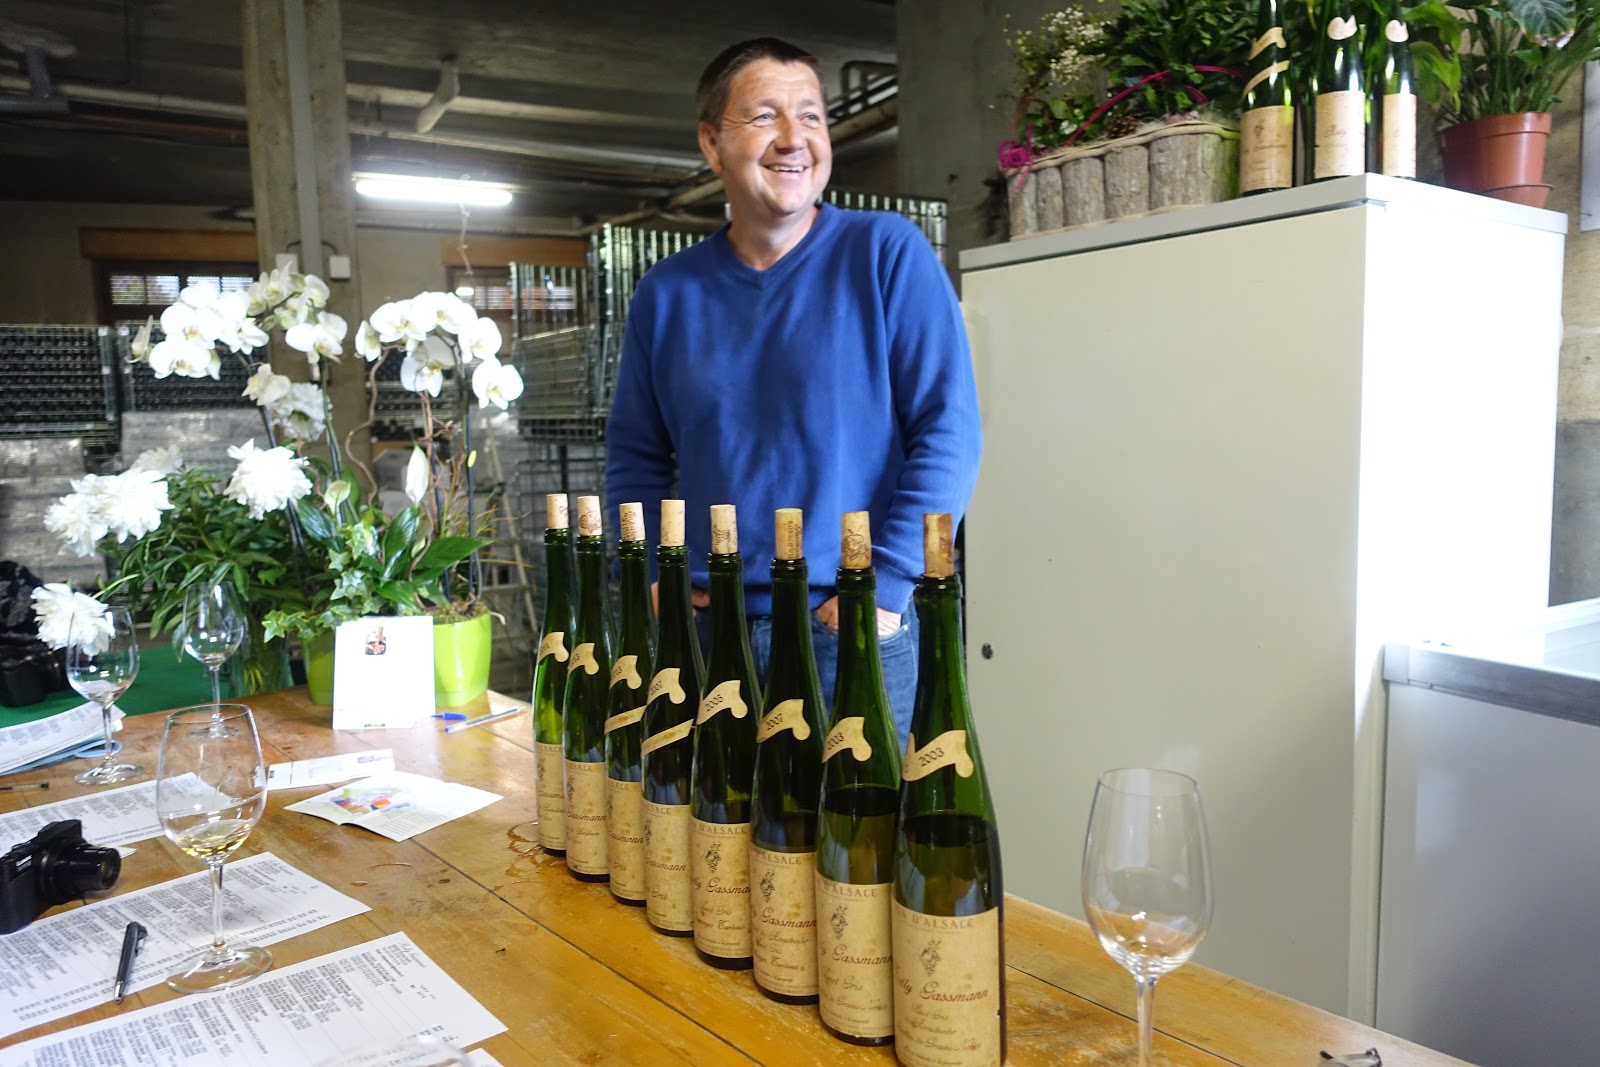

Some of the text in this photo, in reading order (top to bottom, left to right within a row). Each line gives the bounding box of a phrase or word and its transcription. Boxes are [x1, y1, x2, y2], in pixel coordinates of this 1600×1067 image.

[704, 694, 724, 712] 2005
[765, 713, 784, 731] 2007
[826, 732, 845, 751] 2003
[918, 747, 946, 767] 2003
[539, 785, 564, 799] Gassma
[706, 877, 751, 894] Gassma
[761, 907, 817, 928] Gassmann
[912, 916, 975, 929] D'ALSACE
[832, 944, 893, 966] Gassmann
[842, 975, 863, 992] Gris
[920, 980, 989, 1002] Gassmann
